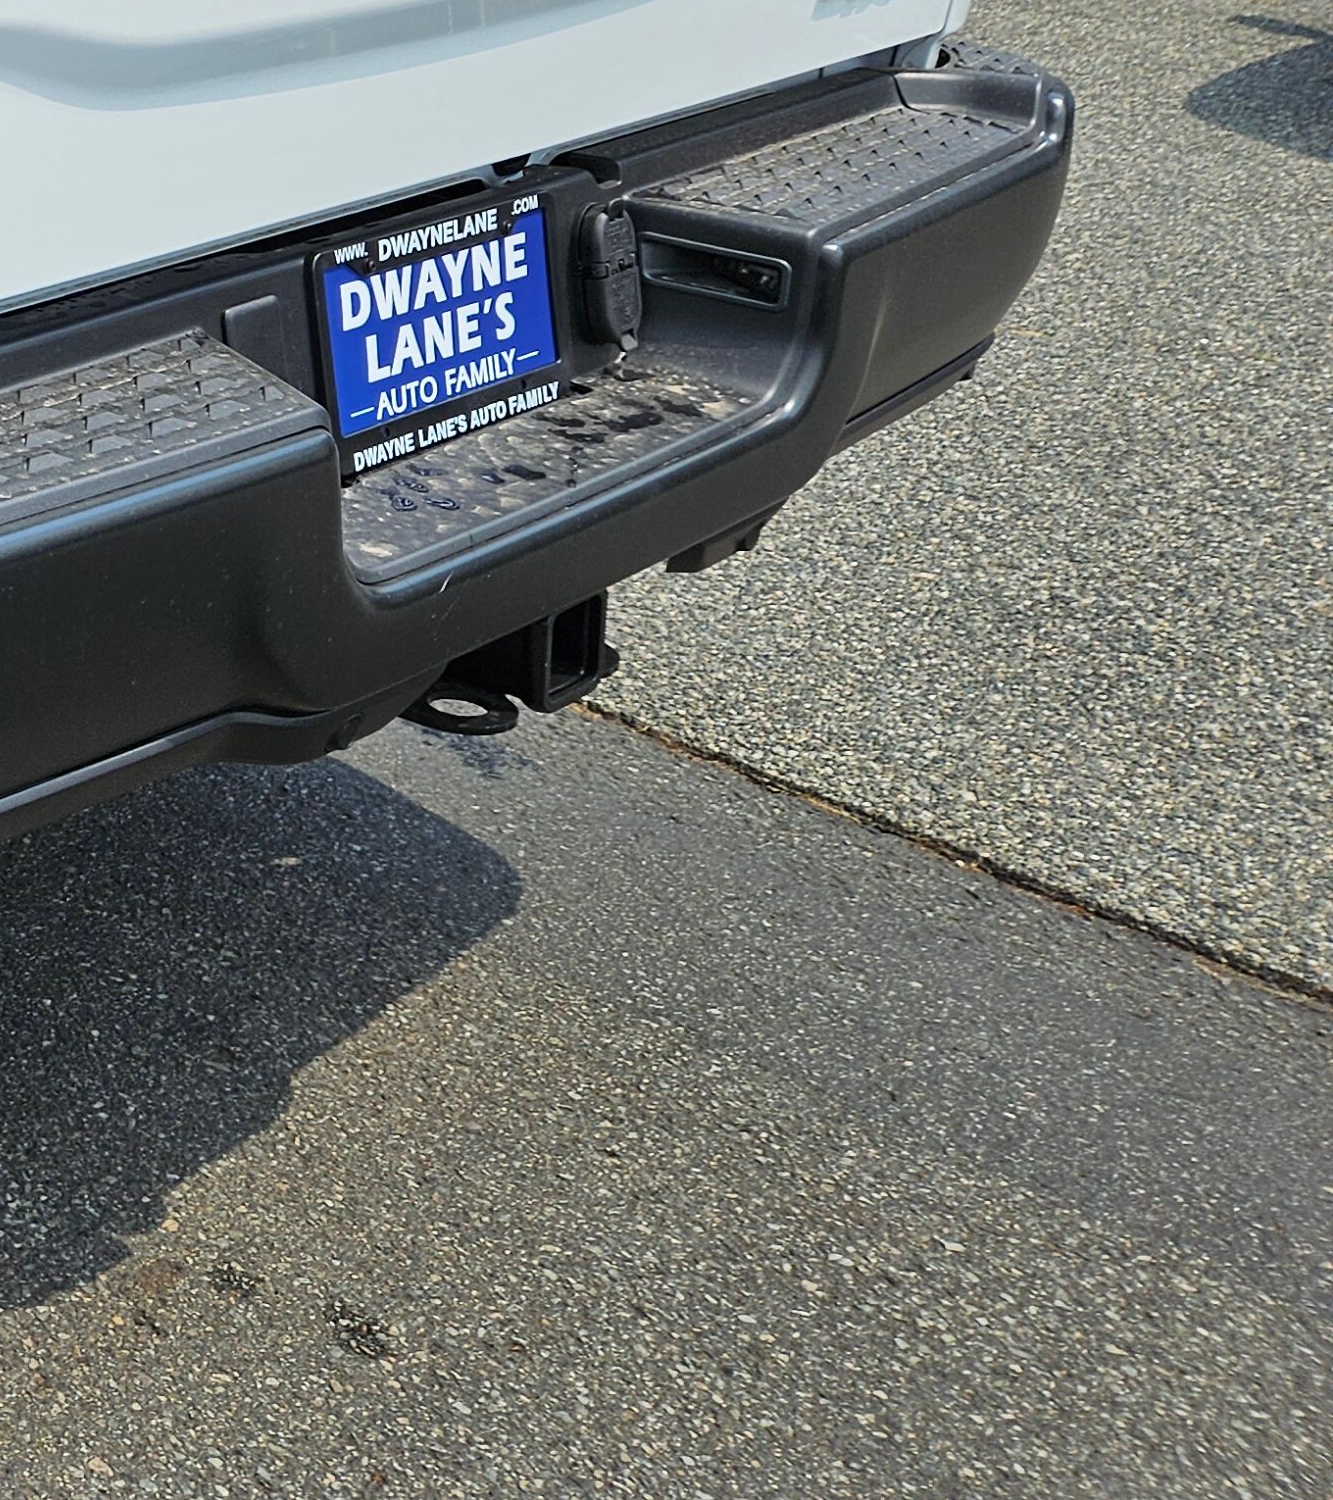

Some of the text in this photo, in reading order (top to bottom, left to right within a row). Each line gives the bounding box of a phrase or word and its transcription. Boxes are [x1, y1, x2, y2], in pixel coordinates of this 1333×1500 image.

[334, 194, 540, 264] WWW. DWAYNELANE .COM
[340, 232, 528, 332] DWAYNE
[365, 291, 516, 383] LANE'S
[353, 381, 560, 472] DWAYNE LANE'S AUTO FAMILY
[376, 348, 516, 421] AUTO FAMILY
